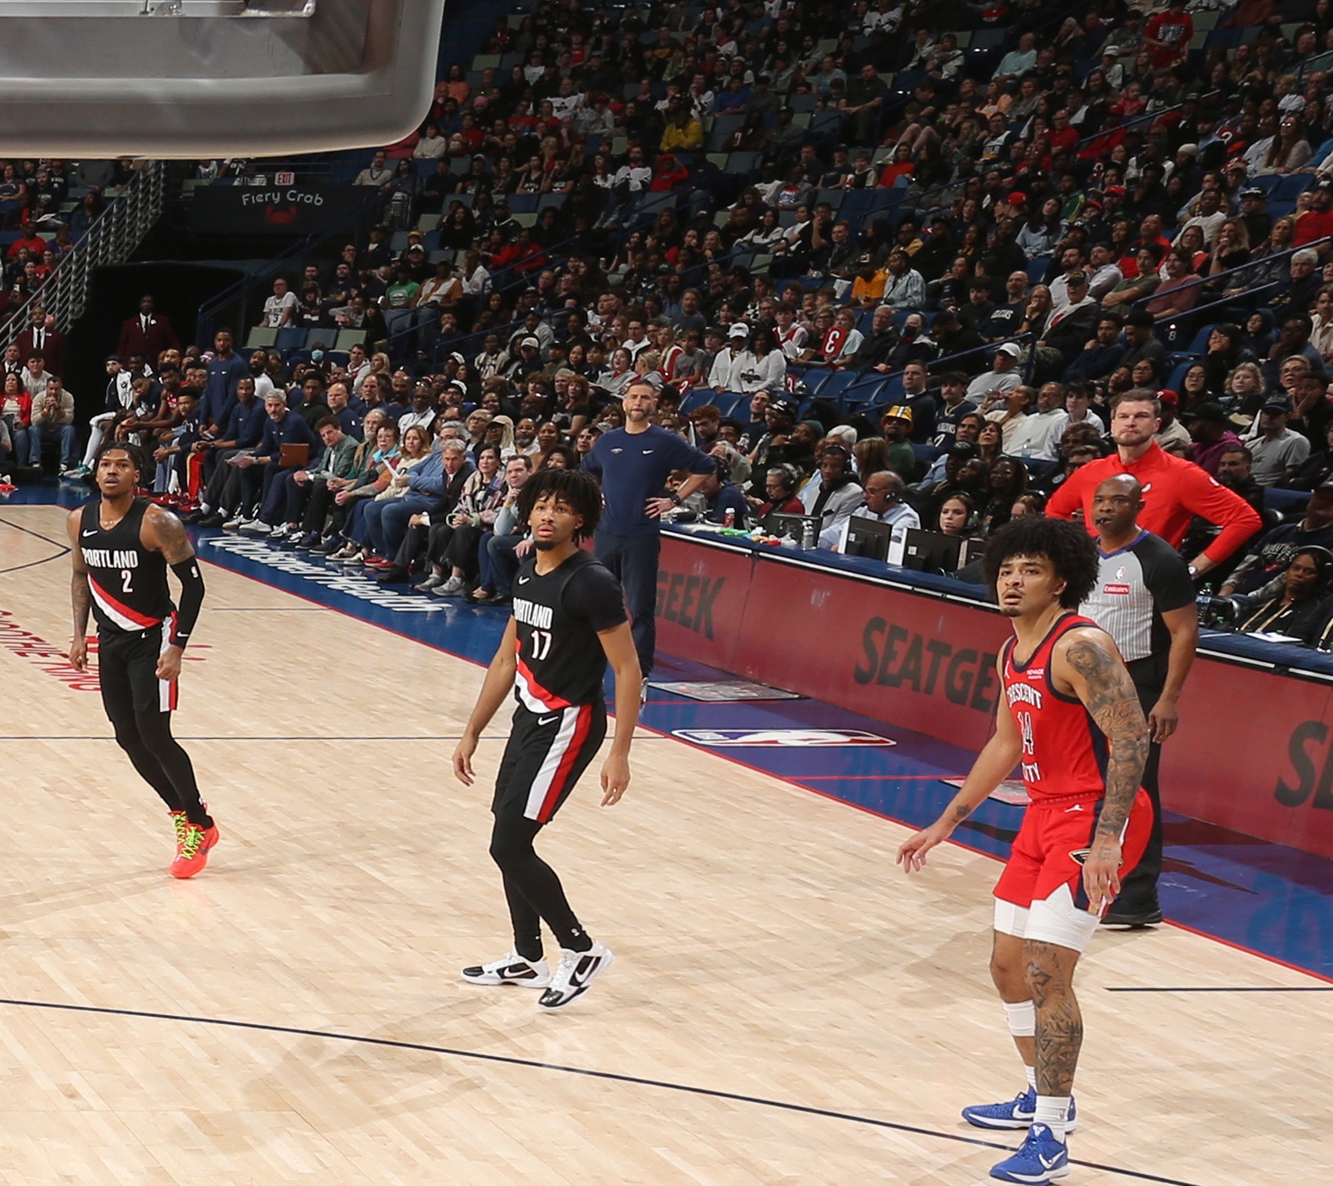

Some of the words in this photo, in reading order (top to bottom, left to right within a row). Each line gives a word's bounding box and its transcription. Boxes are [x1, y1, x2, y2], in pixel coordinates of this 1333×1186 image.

[241, 190, 281, 206] Fiery
[286, 189, 324, 206] Crab
[81, 547, 139, 569] PORTLAND
[120, 569, 134, 593] 2
[1103, 585, 1129, 594] Emirates
[655, 570, 727, 643] GEEK
[530, 629, 553, 661] 17
[852, 616, 1000, 714] SEATGE
